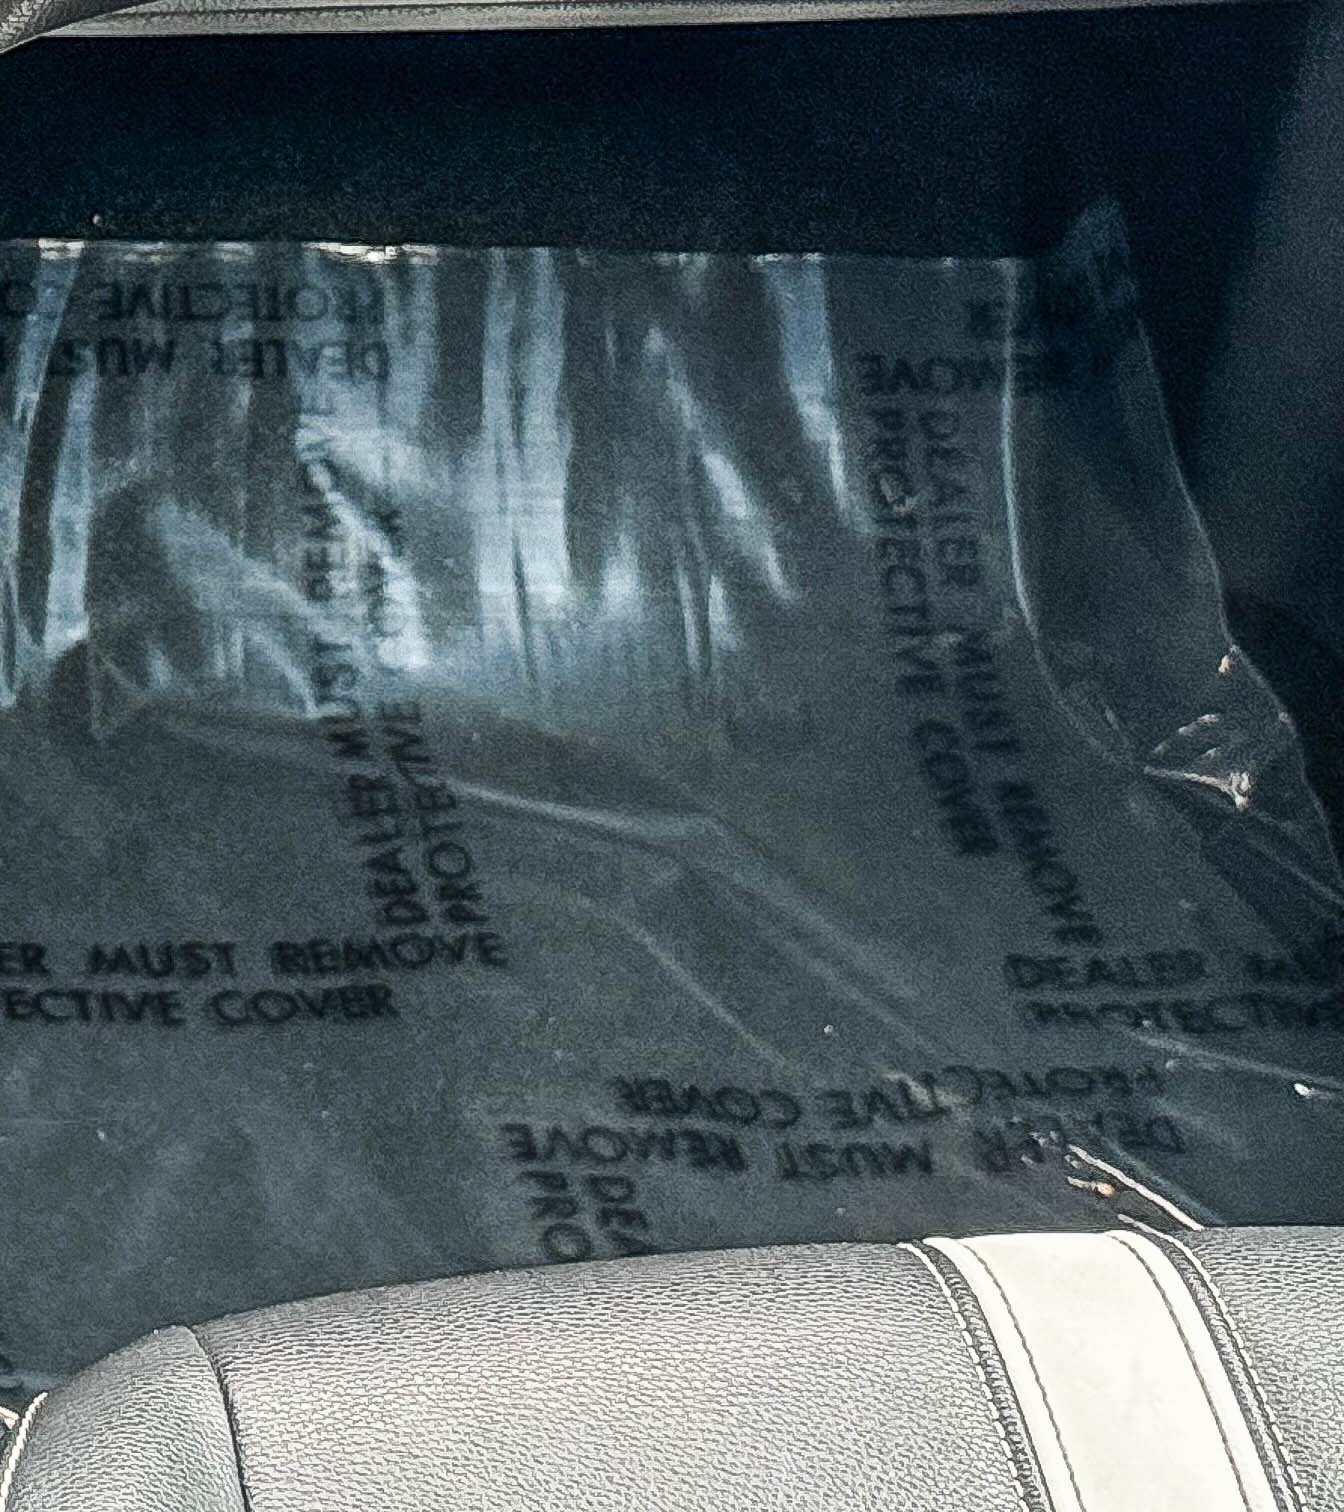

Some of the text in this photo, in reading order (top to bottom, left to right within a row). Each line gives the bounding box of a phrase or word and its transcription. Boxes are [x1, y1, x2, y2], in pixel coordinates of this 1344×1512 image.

[85, 939, 238, 980] MUST
[270, 932, 510, 977] REMOVE
[212, 986, 399, 1027] COVER
[499, 1123, 742, 1178] REMOVE
[773, 1139, 934, 1184] MUST
